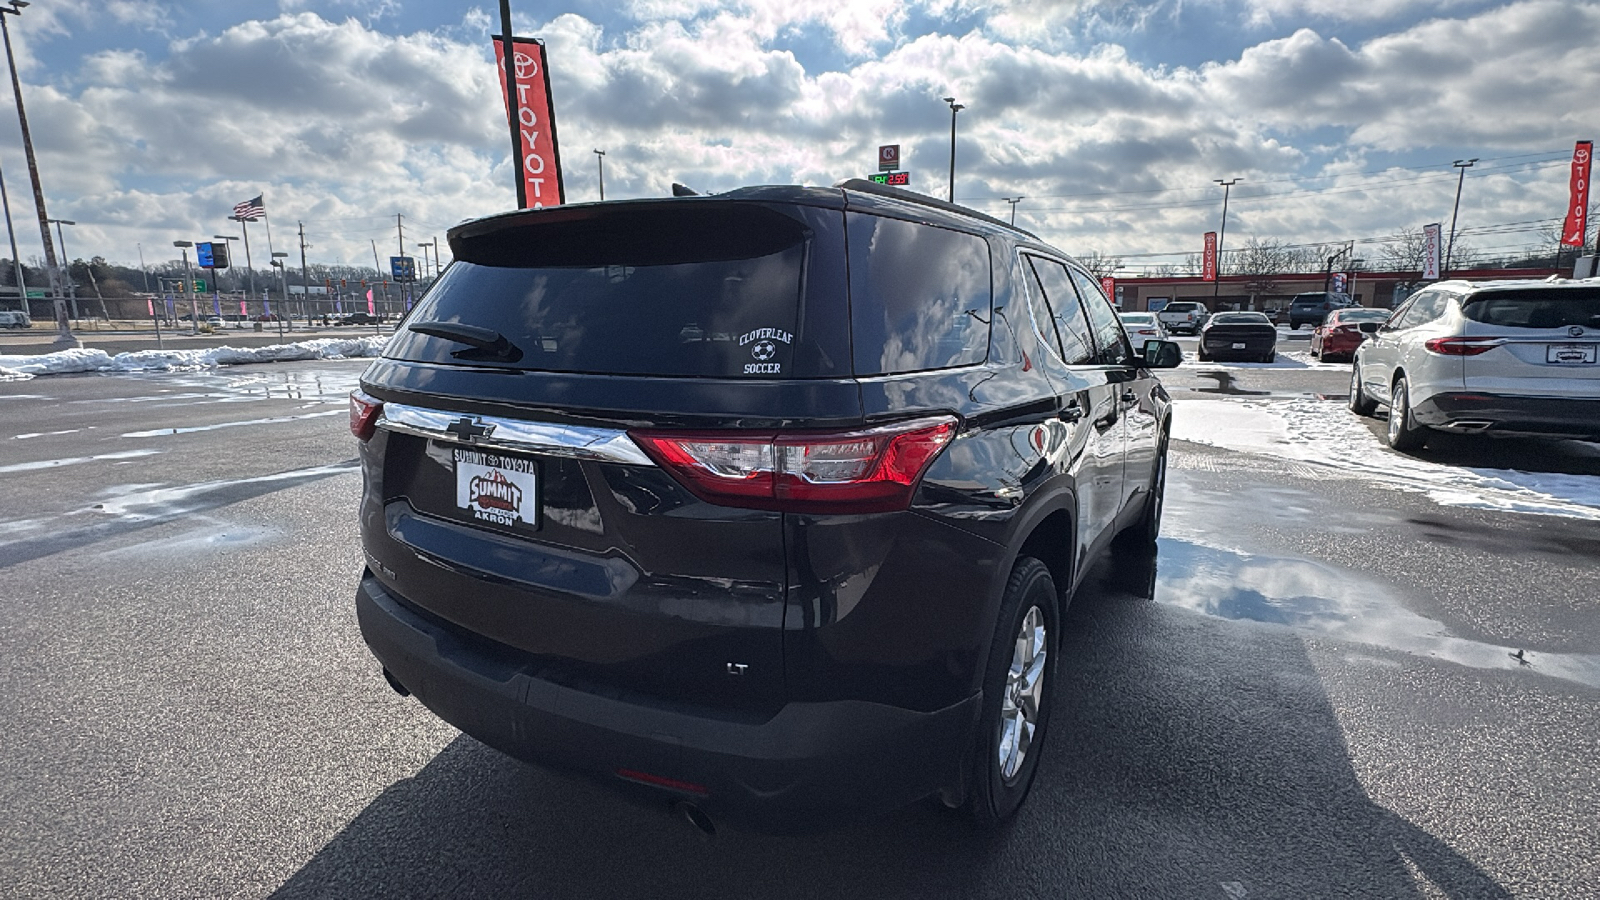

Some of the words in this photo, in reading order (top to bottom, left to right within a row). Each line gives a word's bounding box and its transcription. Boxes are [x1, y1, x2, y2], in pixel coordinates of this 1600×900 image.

[516, 84, 545, 208] TOYOT
[1569, 167, 1585, 242] TOYOTA
[1427, 237, 1435, 275] TOYOTA
[739, 328, 792, 345] CLOVERLEAF
[743, 363, 781, 374] SOCCER
[454, 449, 487, 466] SUMMIT
[499, 456, 534, 474] TOYOTA
[471, 478, 521, 509] SUMMIT
[474, 511, 513, 526] AKRON
[727, 662, 749, 675] LT
